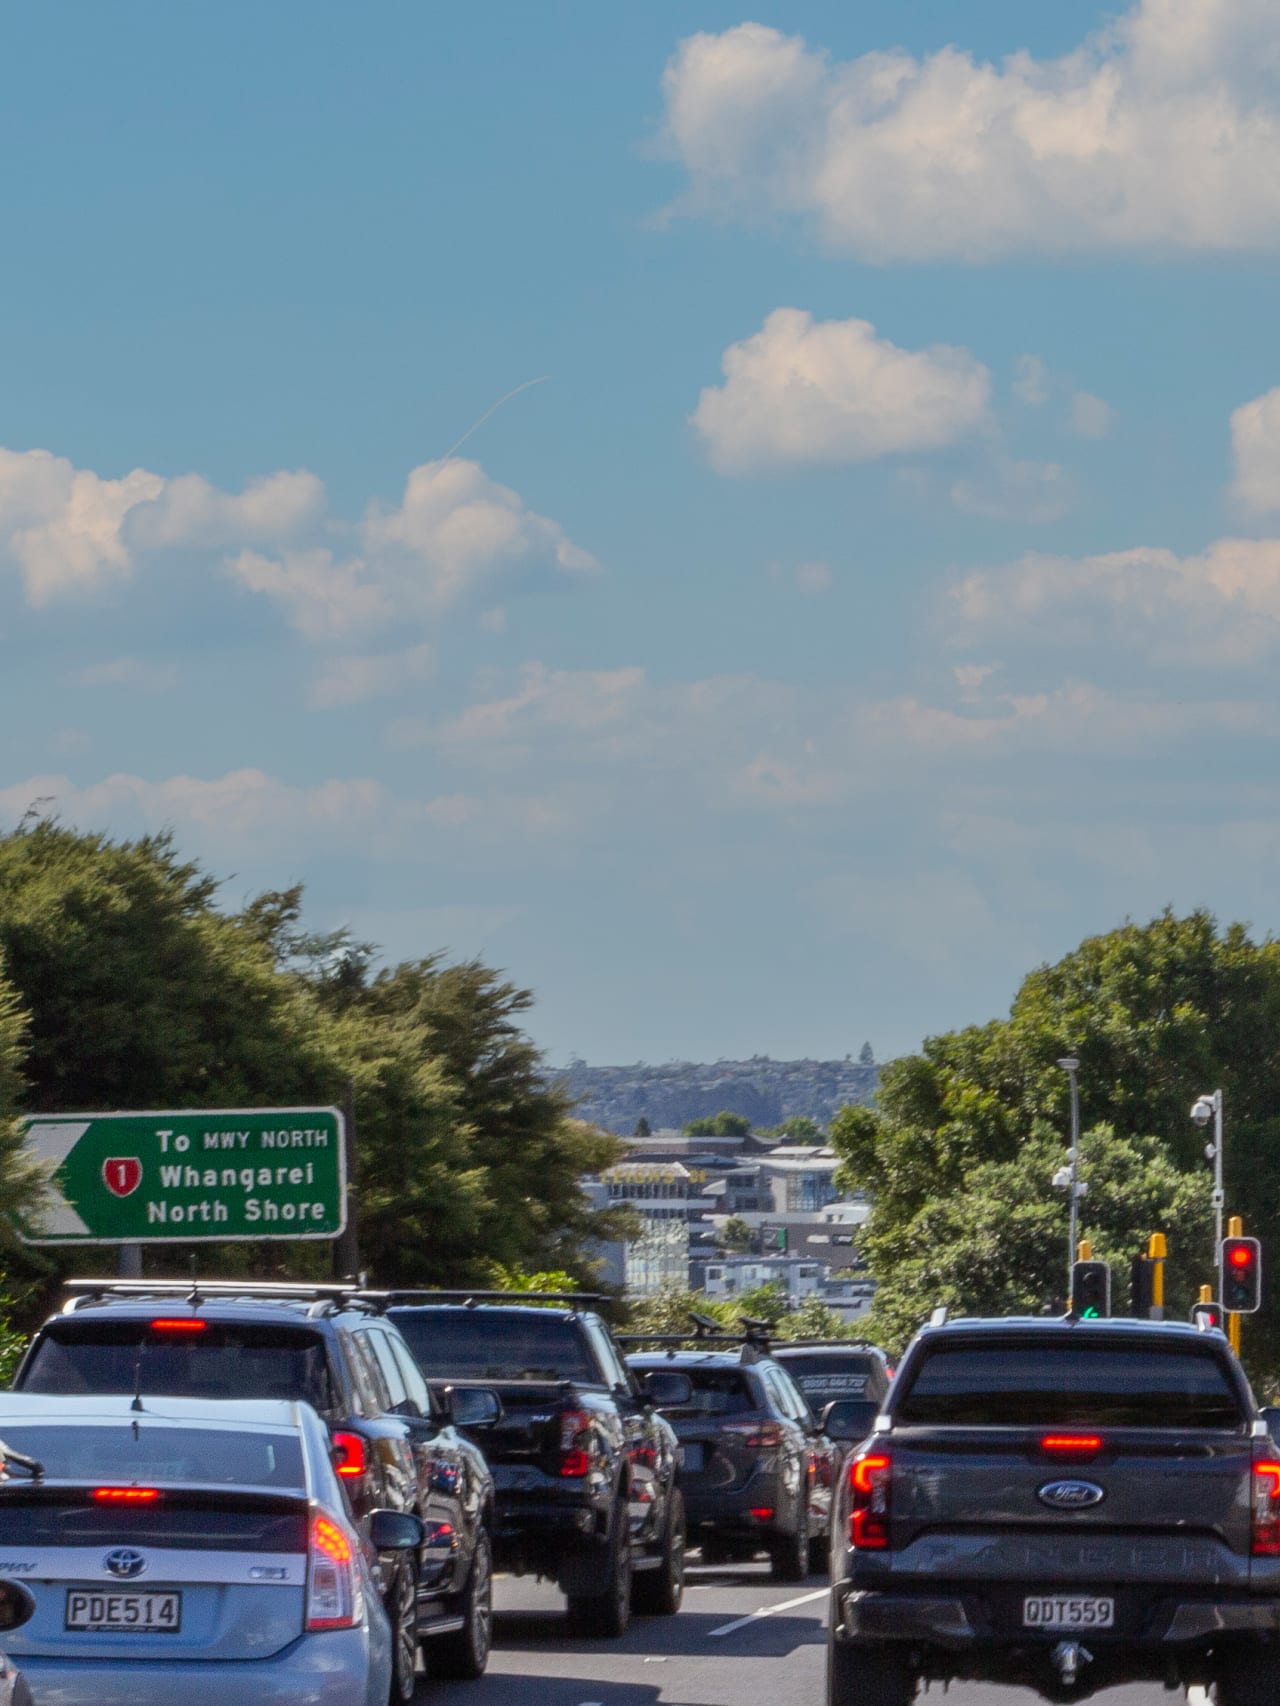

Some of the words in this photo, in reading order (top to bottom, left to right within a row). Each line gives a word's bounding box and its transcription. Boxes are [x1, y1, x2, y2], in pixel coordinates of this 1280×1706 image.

[156, 1130, 190, 1152] To
[204, 1131, 250, 1149] MWY
[261, 1129, 328, 1148] NORTH
[117, 1164, 127, 1187] 1
[160, 1162, 313, 1192] Whangarei
[148, 1201, 229, 1223] North
[244, 1198, 325, 1221] Shore
[1053, 1484, 1090, 1502] Ford
[71, 1596, 175, 1623] PDE514
[1027, 1599, 1111, 1624] QDT559
